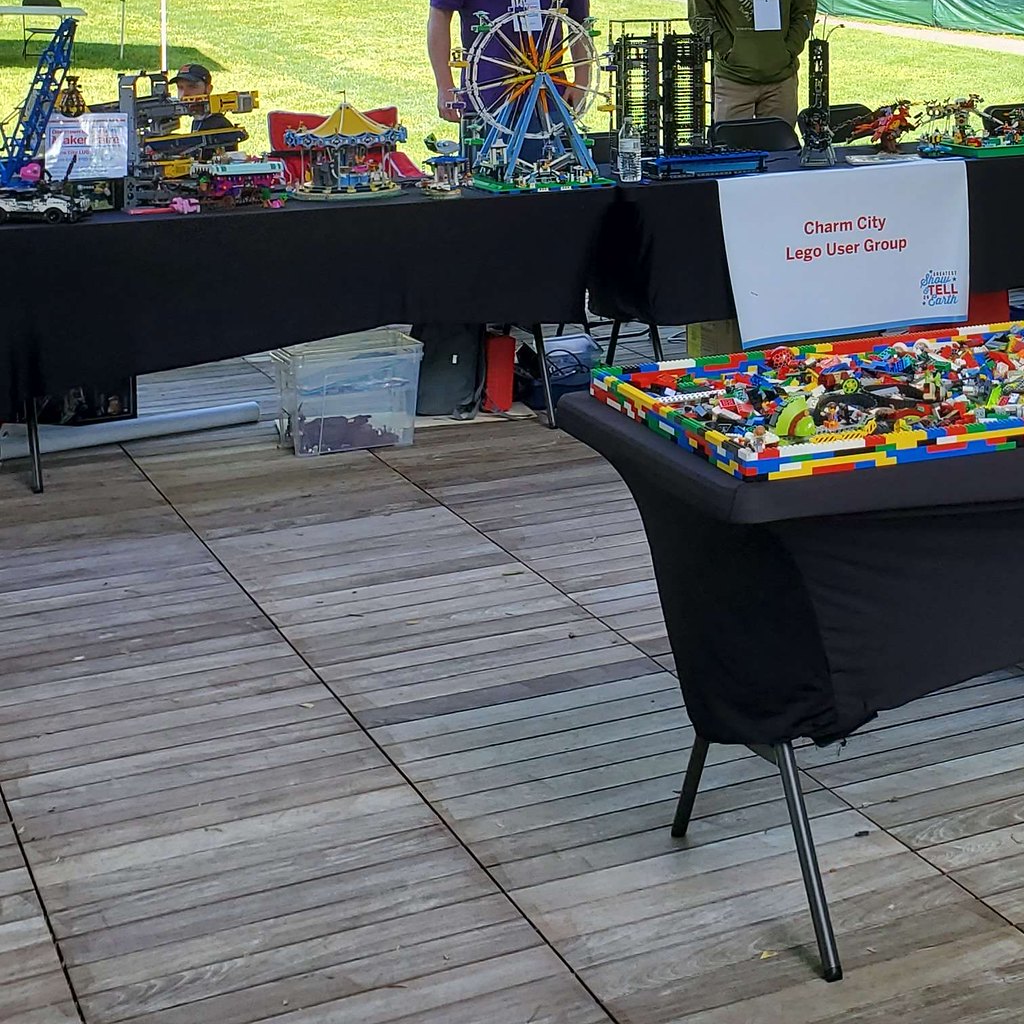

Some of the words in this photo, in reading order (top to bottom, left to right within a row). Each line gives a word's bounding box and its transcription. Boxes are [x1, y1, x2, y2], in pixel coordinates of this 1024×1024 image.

[804, 220, 853, 235] Charm
[857, 216, 886, 232] City
[786, 247, 822, 262] Lego
[826, 242, 860, 256] User
[864, 238, 907, 252] Group
[920, 273, 951, 288] Show
[928, 283, 958, 296] TELL
[928, 294, 958, 306] Earth
